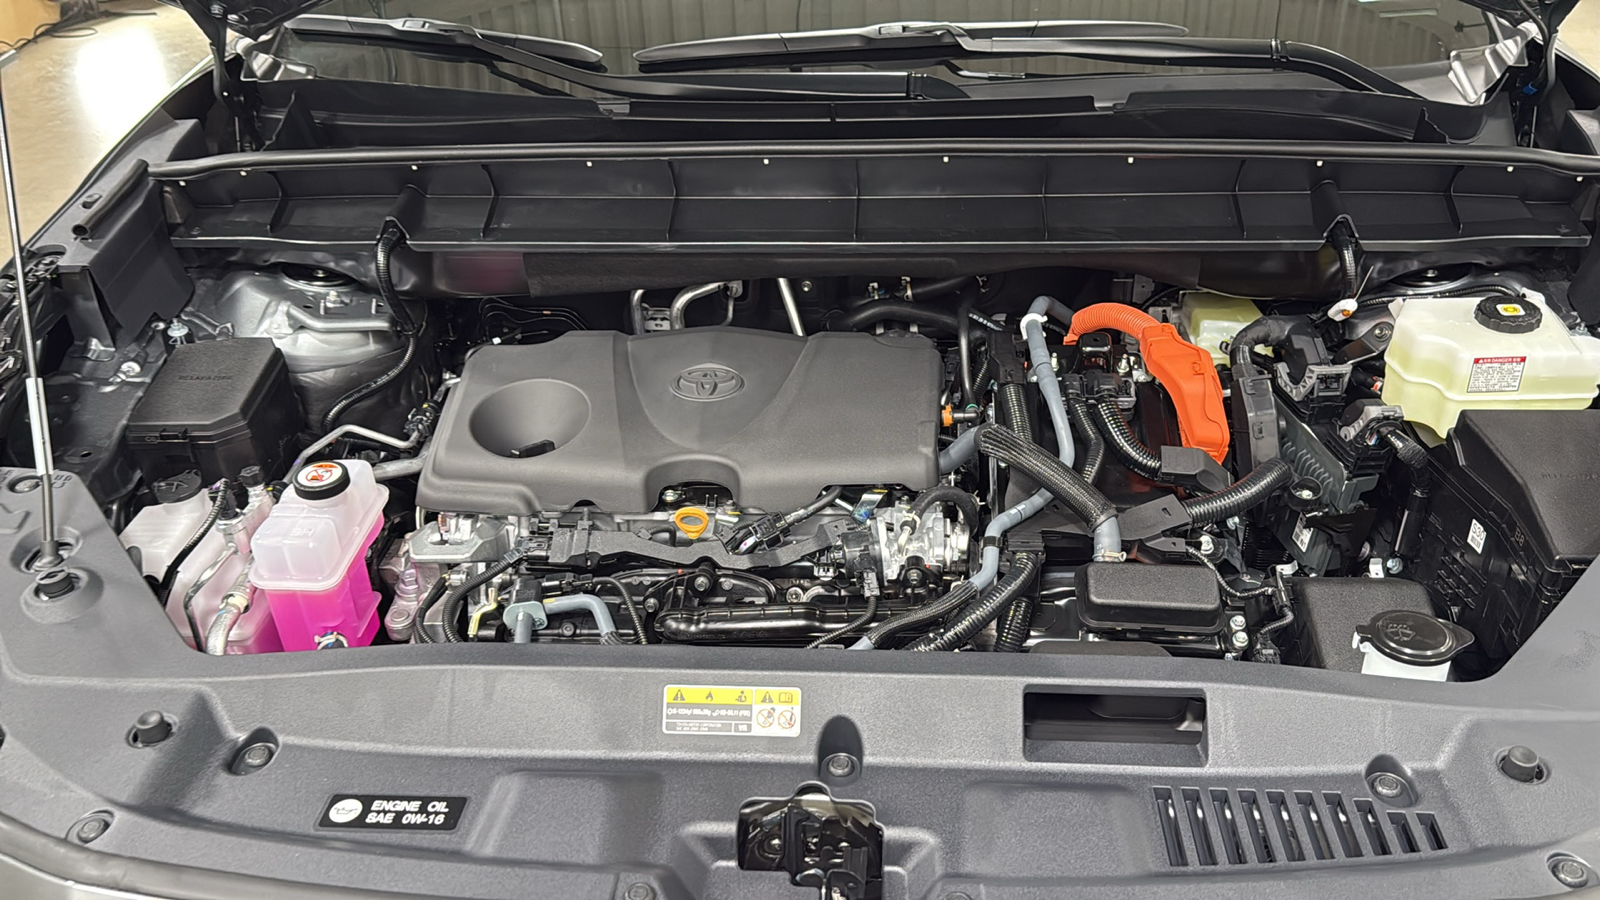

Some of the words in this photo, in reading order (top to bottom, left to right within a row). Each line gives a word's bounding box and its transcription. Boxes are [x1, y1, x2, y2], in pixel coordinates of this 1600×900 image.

[371, 799, 422, 812] ENGINE
[427, 801, 449, 813] OIL
[365, 812, 395, 824] SAE
[402, 813, 446, 825] 0W-16
